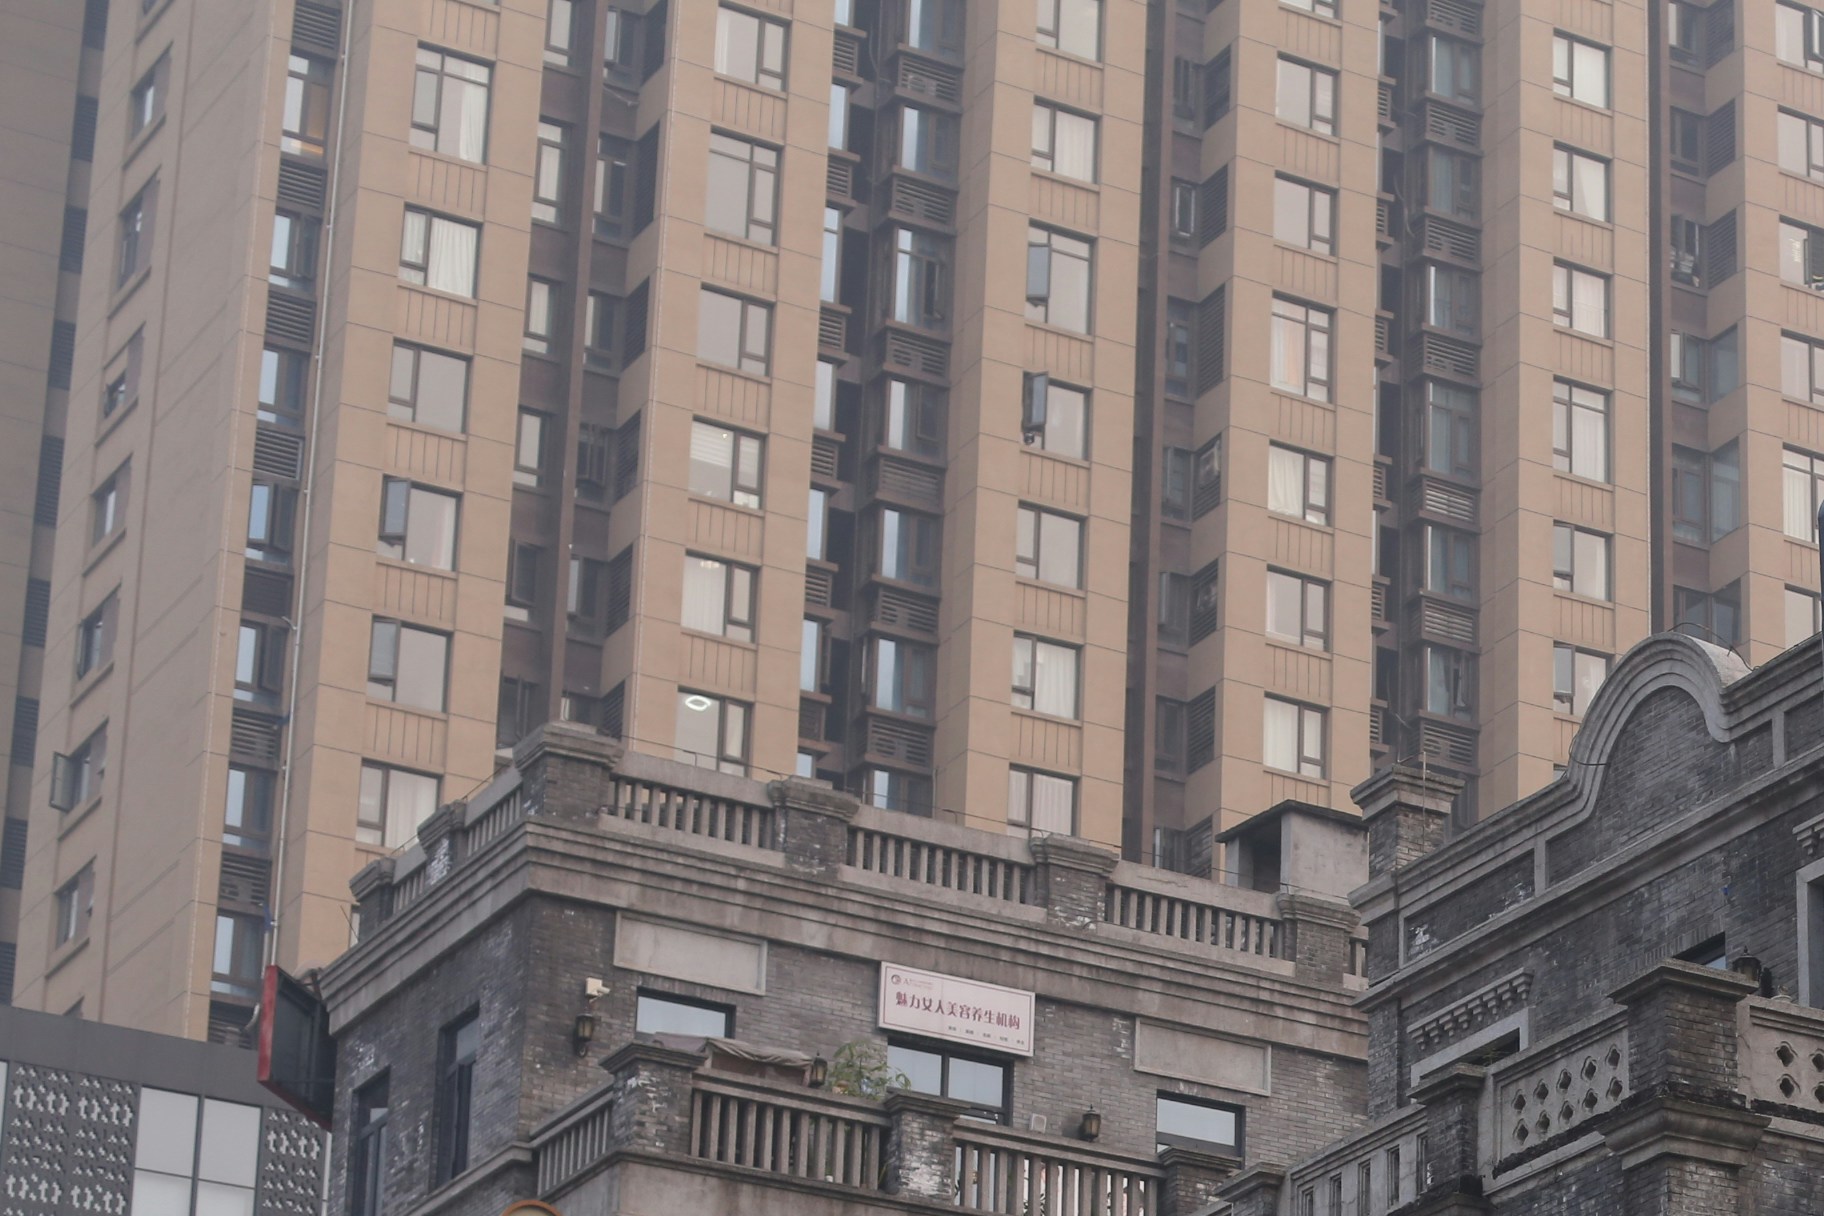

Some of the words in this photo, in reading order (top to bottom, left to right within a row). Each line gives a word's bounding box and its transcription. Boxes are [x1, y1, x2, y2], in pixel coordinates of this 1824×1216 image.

[895, 991, 1020, 1030] 魅力女人美容养生机构
